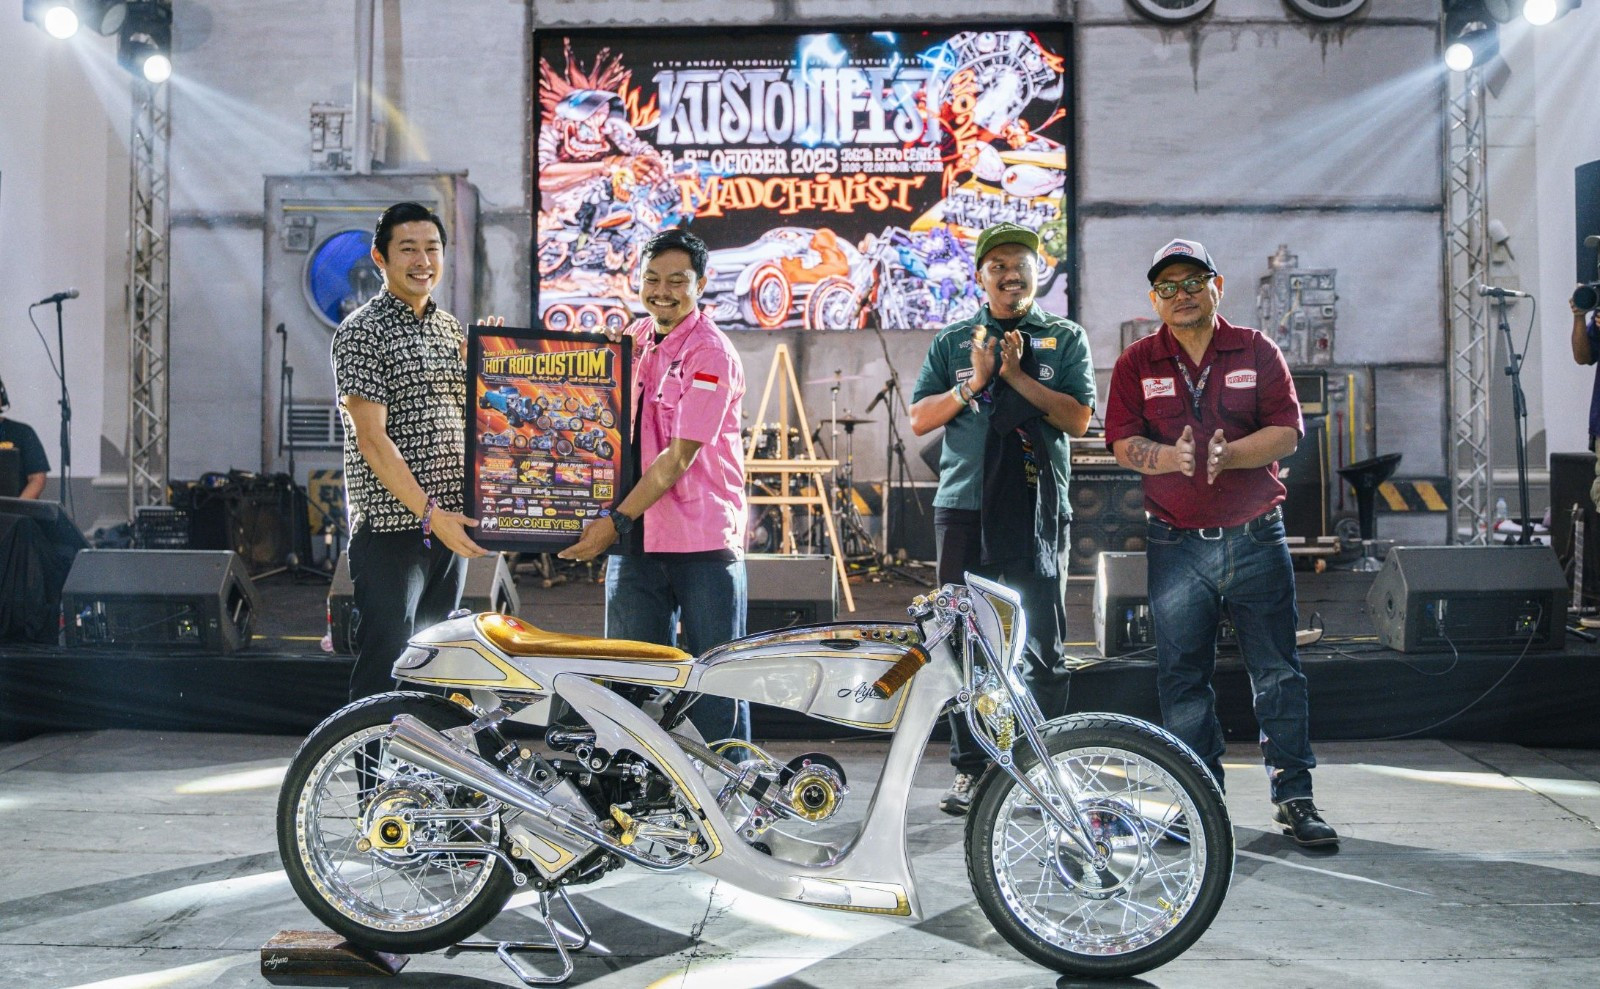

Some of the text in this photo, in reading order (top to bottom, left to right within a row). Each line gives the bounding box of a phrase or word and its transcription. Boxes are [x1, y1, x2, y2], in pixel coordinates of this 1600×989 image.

[686, 59, 727, 67] ANNUAL
[733, 59, 798, 67] INDONESIAN
[651, 68, 947, 145] KUSTOMFEST
[710, 148, 788, 174] OCTOBER
[790, 148, 838, 174] 2025
[873, 147, 902, 161] EXPO
[902, 146, 942, 162] CENTER
[676, 173, 927, 218] MADCHINIST
[485, 350, 607, 377] HOT ROD CUSTOM
[498, 516, 581, 530] MOONEYES
